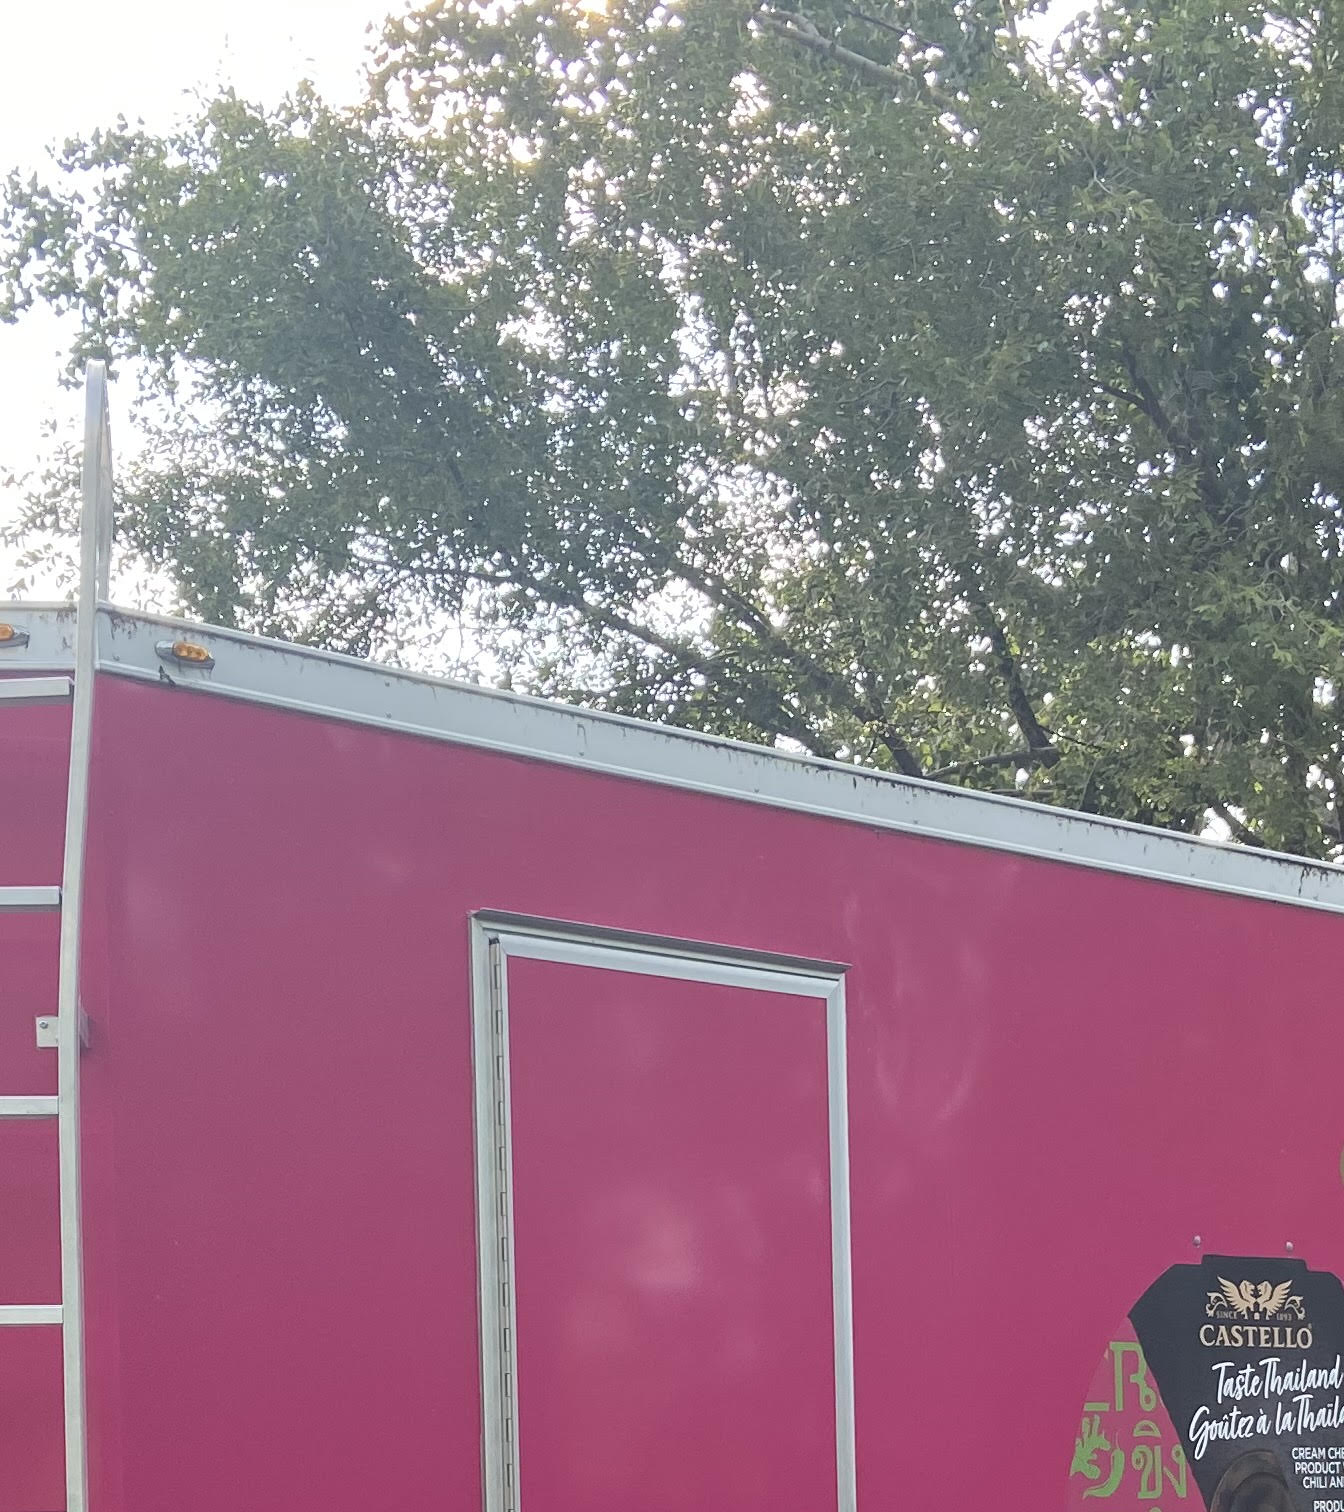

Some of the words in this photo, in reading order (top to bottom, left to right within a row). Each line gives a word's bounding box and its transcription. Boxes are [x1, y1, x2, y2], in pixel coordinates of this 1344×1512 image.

[1199, 1324, 1313, 1349] CASTELLO
[1211, 1361, 1264, 1404] Taste
[1259, 1354, 1344, 1399] Thailand
[1189, 1405, 1255, 1460] Goûtez
[1256, 1408, 1272, 1435] à
[1275, 1401, 1297, 1436] la
[1291, 1446, 1326, 1460] CREAM
[1295, 1461, 1341, 1475] PRODUCT
[1302, 1475, 1328, 1489] CHILI
